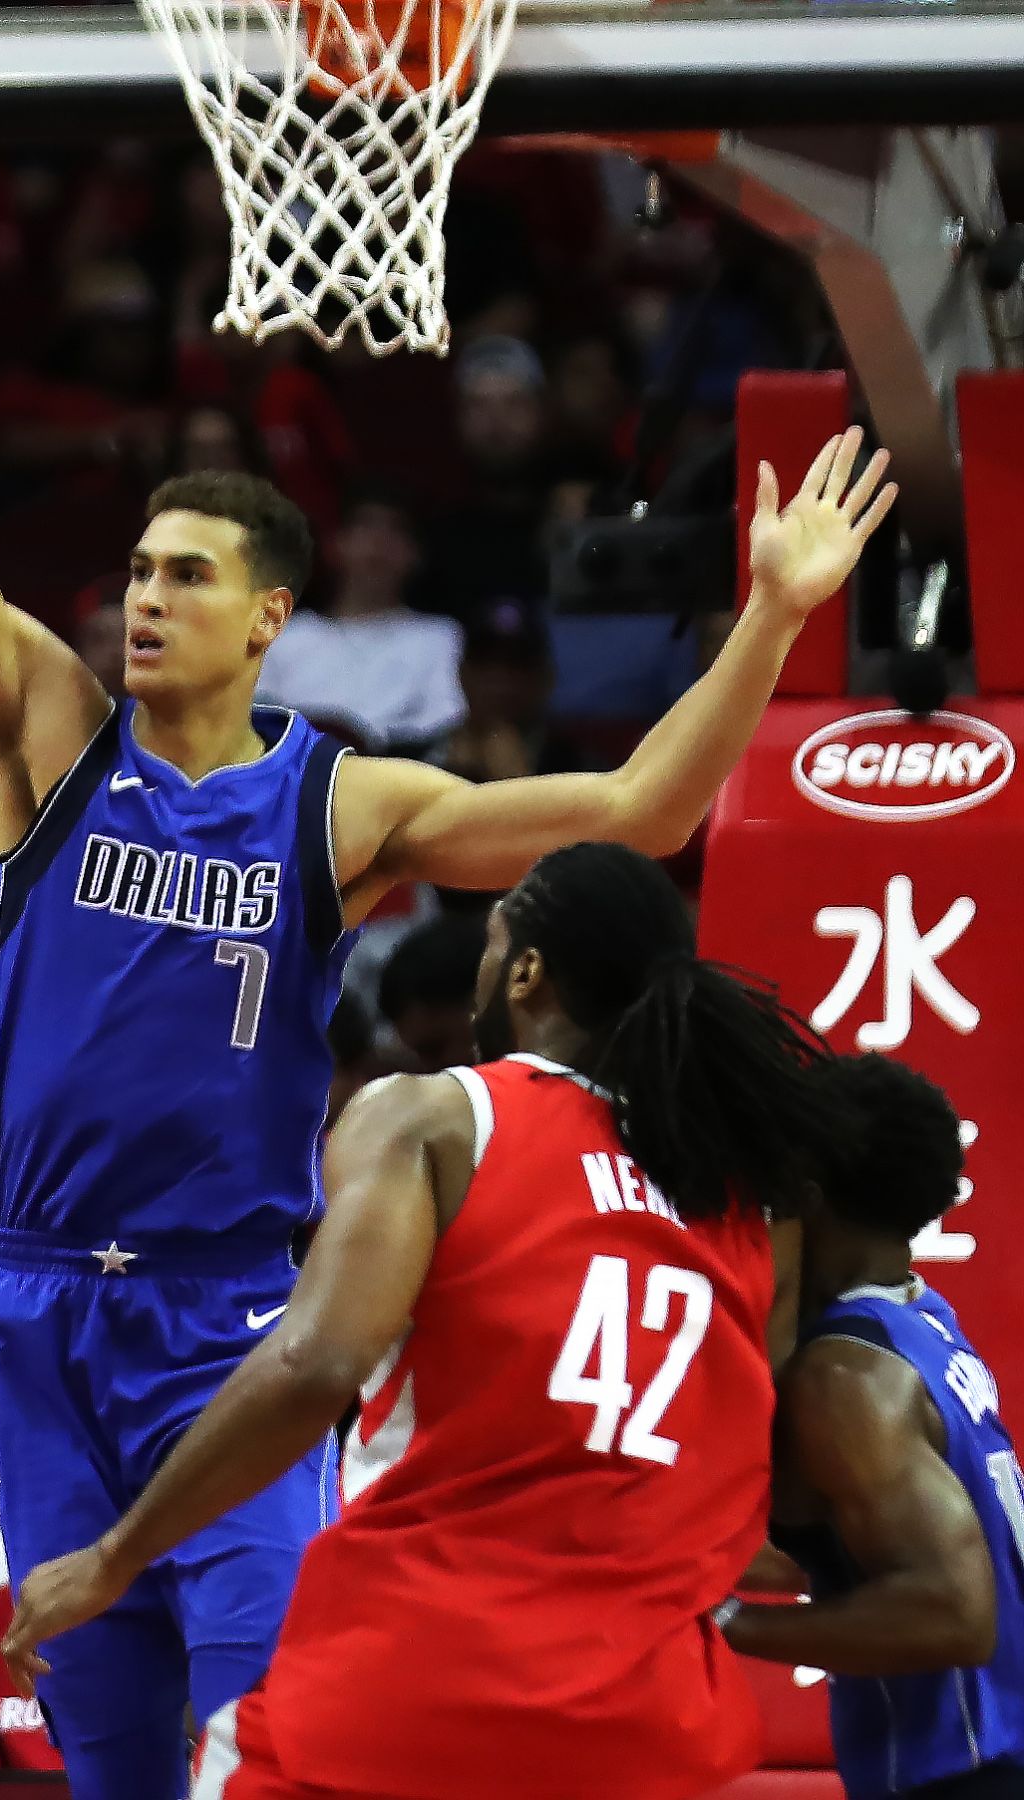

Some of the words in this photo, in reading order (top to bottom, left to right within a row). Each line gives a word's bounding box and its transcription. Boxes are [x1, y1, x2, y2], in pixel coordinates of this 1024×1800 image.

[808, 742, 1004, 789] SCISKY
[74, 833, 281, 935] DALLAS
[214, 938, 269, 1049] 7
[811, 874, 981, 1052] 水
[547, 1254, 714, 1466] 42
